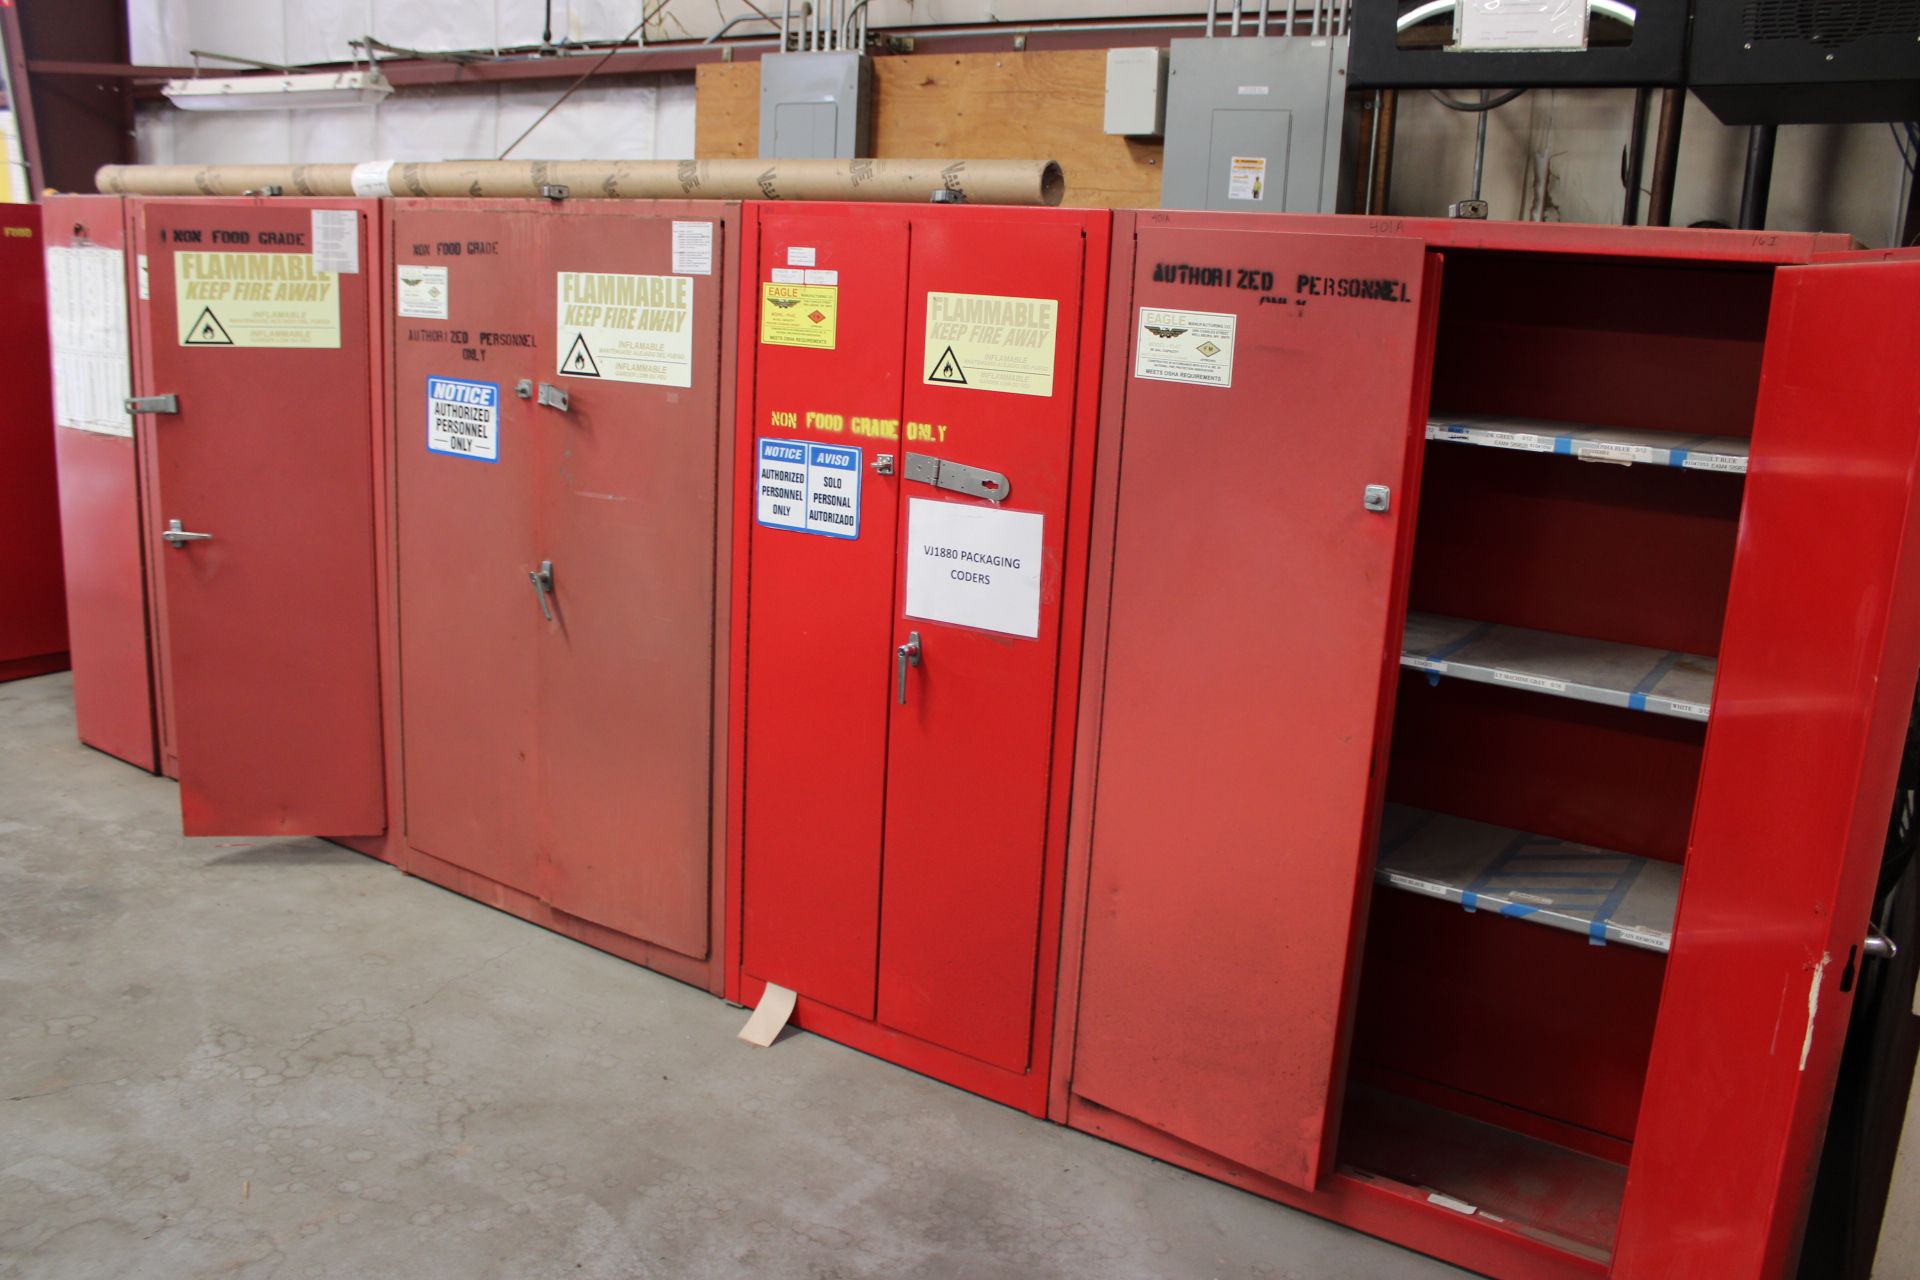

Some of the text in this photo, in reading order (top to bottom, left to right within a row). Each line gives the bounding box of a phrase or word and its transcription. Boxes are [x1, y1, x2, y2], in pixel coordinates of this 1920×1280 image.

[1369, 221, 1404, 233] 401A
[173, 229, 305, 246] NON FOOD GRADE
[437, 242, 461, 255] FOOD
[467, 241, 499, 255] GRADE
[185, 281, 331, 301] KEEP FIRE AWAY
[563, 273, 687, 309] FLAMMABLE
[1153, 263, 1411, 303] AUTHORIZED PERSONNEL
[768, 287, 799, 297] EAGLE
[564, 304, 687, 333] KEEP FIRE AWAY
[932, 297, 1051, 329] FLAMMABLE
[1146, 313, 1186, 326] EAGLE
[408, 329, 537, 348] AUTHORIZED PERSONNEL
[930, 322, 1049, 348] KEEP FIRE AWAY
[618, 340, 664, 351] INFLAMABLE
[462, 348, 486, 361] ONLY
[616, 362, 668, 374] INFLAMMABLE
[1180, 372, 1221, 382] REQUIREMENTS
[433, 382, 492, 405] NOTICE
[435, 402, 490, 422] AUTHORIZED
[436, 418, 488, 439] PERSONNEL
[771, 411, 947, 442] NON FOOD GRADE ONLY
[451, 436, 472, 452] ONLY
[764, 446, 802, 460] NOTICE
[816, 452, 850, 466] AVISO
[761, 469, 804, 484] AUTHORIZED
[823, 476, 842, 489] SOLO
[762, 485, 803, 501] PERSONNEL
[813, 492, 851, 508] PERSONAL
[773, 504, 791, 516] ONLY
[809, 510, 854, 526] AUTORIZADO
[924, 545, 1020, 569] VJ1880 PACKAGING
[950, 569, 990, 585] CODERS
[1672, 703, 1691, 711] WHITE
